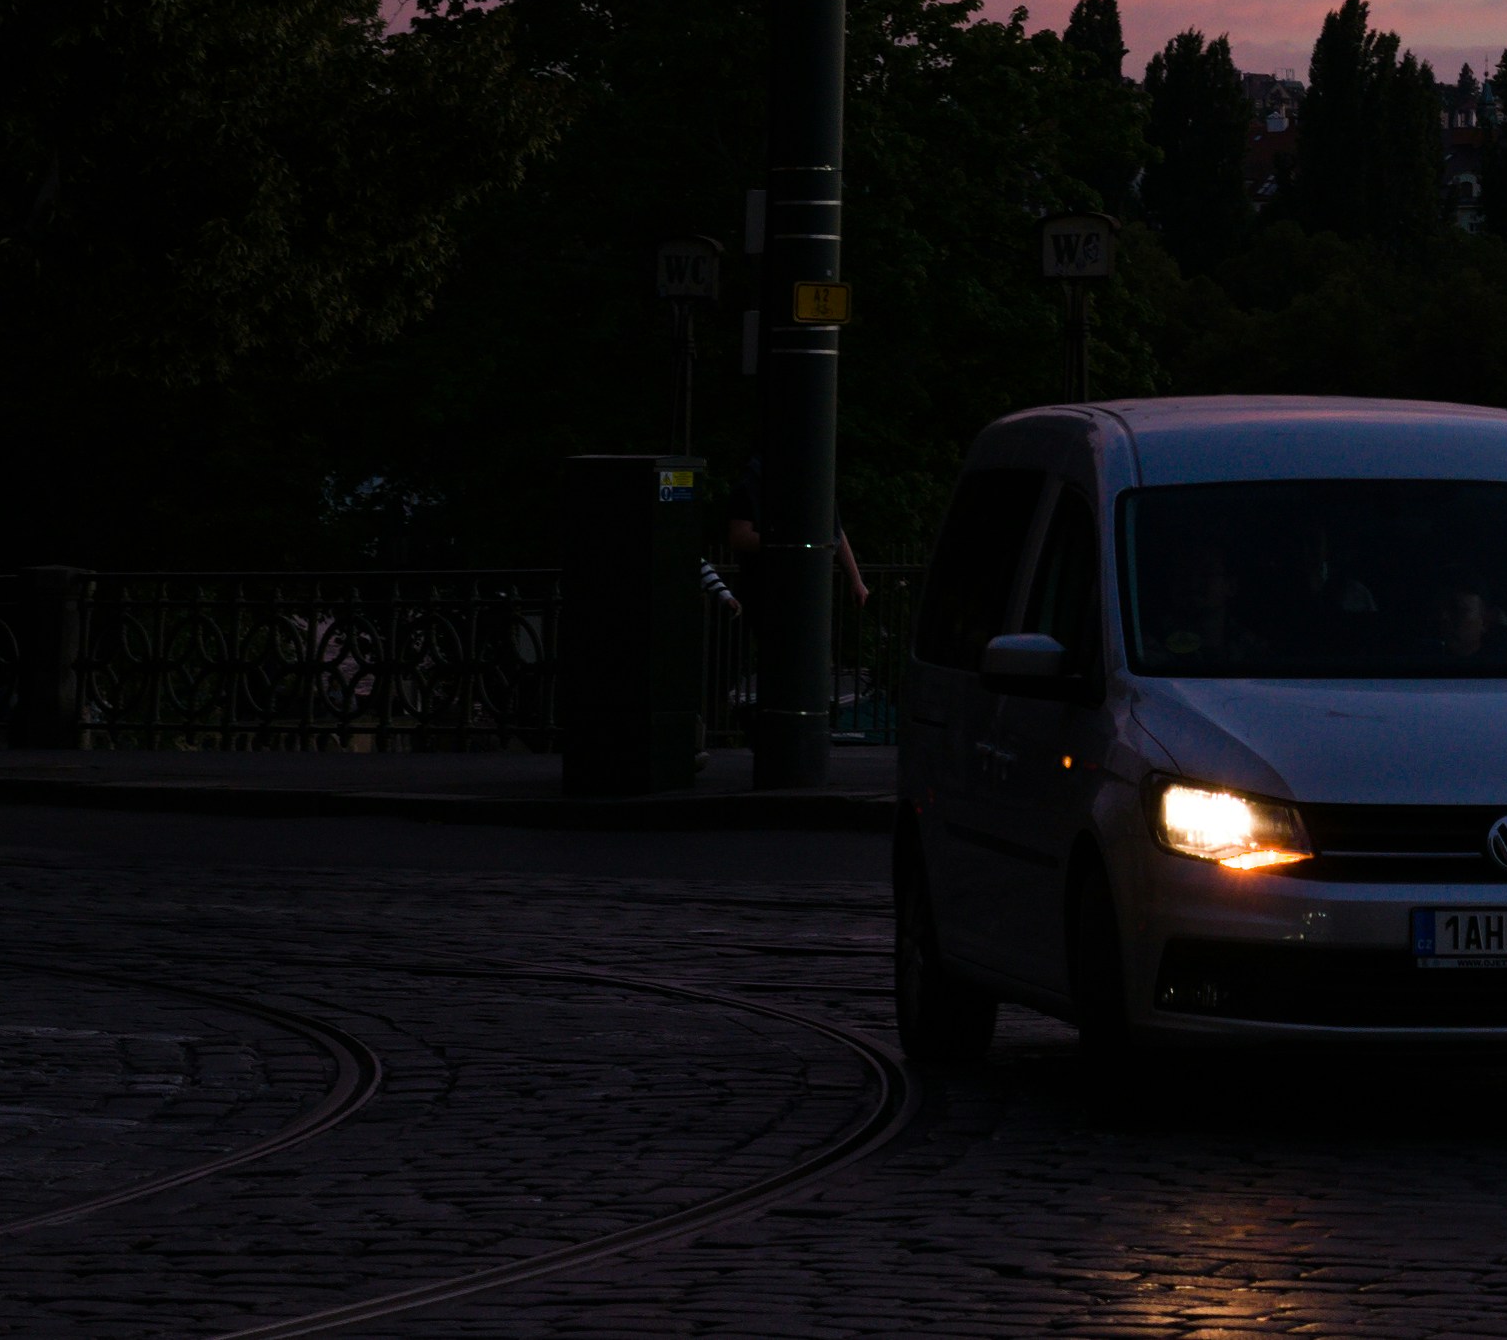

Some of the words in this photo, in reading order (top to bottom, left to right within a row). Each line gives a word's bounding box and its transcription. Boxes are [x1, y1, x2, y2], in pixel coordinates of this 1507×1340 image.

[664, 255, 705, 284] WC
[1417, 939, 1433, 950] CZ
[1444, 915, 1504, 950] 1AH
